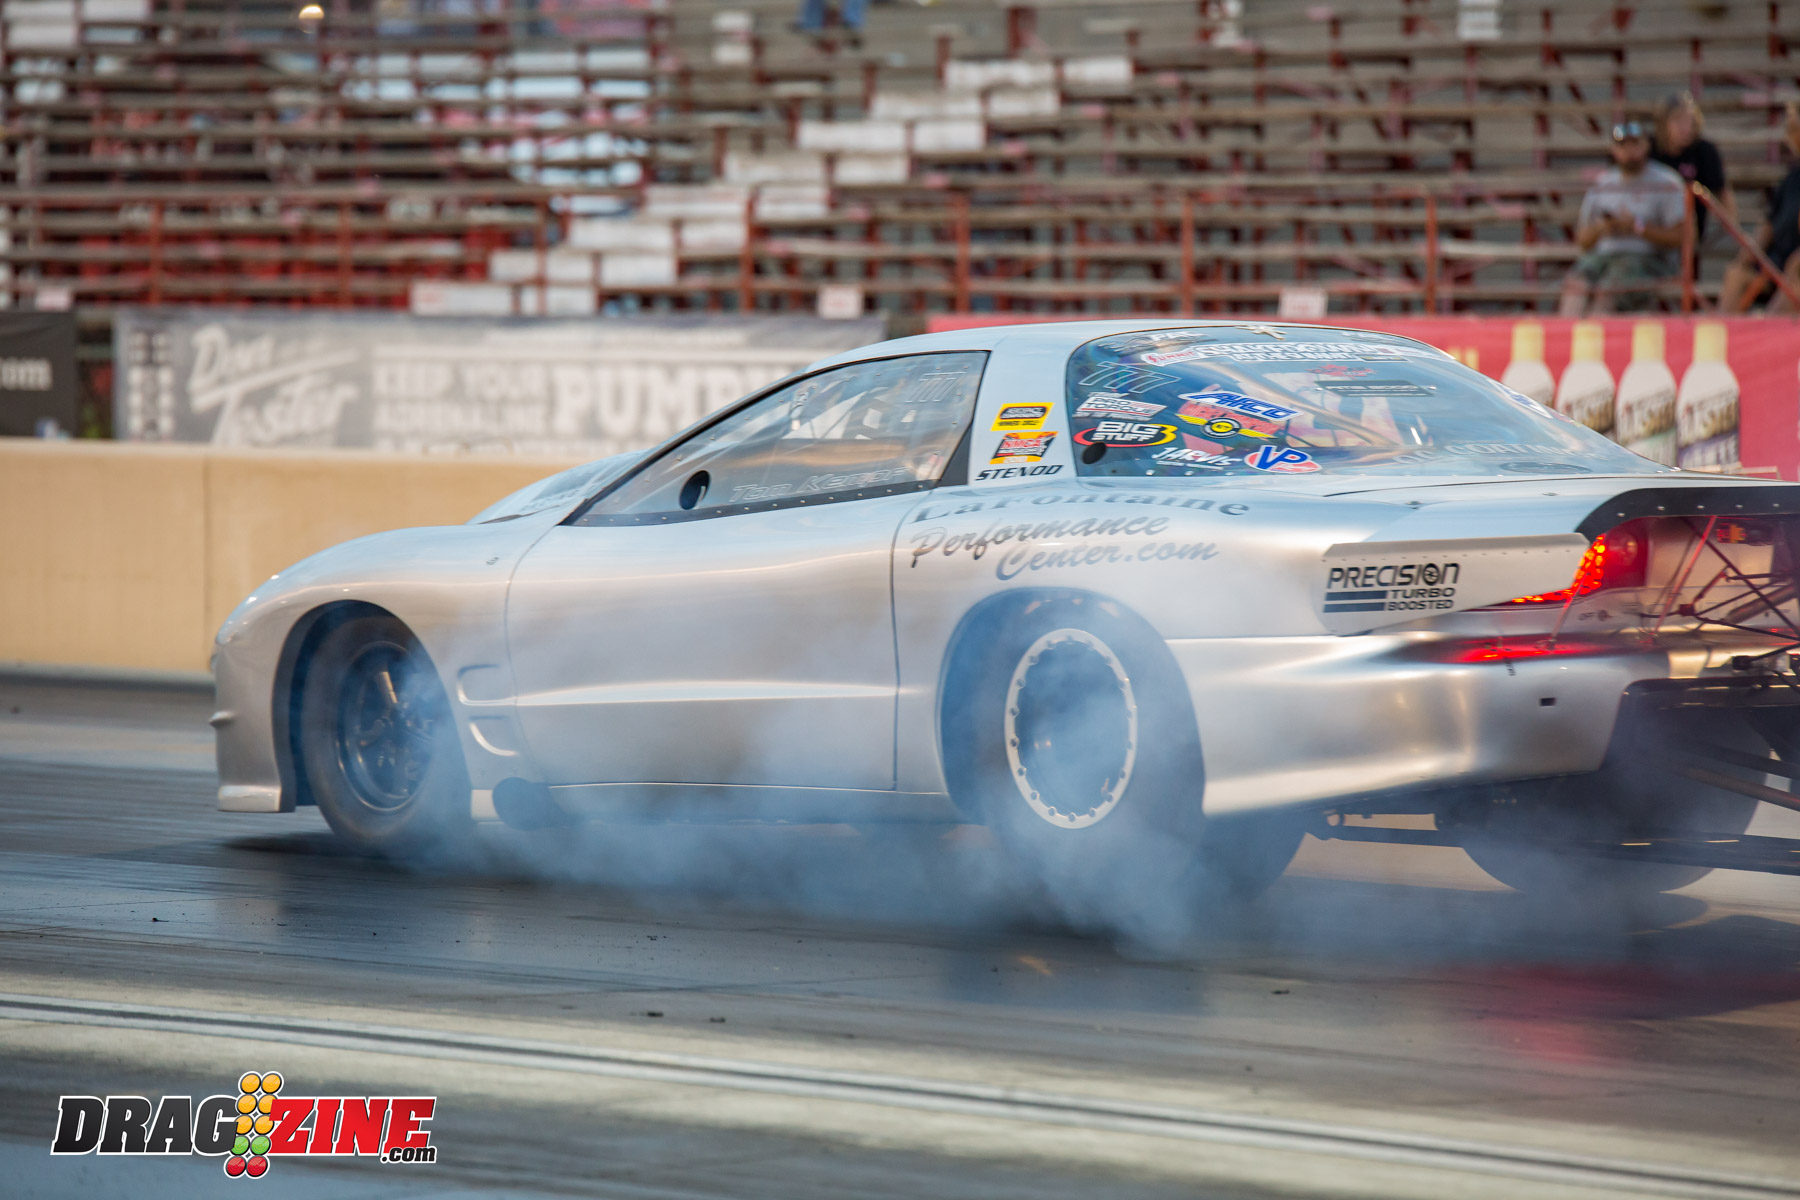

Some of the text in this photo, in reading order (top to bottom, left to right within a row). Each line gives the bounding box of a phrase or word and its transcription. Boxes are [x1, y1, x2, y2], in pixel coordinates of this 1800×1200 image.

[1096, 421, 1162, 434] BIG
[1091, 432, 1156, 442] STUFF
[1151, 447, 1243, 466] JARVIS
[1257, 446, 1309, 470] VP
[975, 464, 1065, 481] STENOD
[910, 515, 1171, 569] Performance
[995, 540, 1221, 582] Center.com
[1327, 562, 1461, 589] PRECISION
[1390, 587, 1456, 599] TURBO
[1387, 600, 1454, 611] BOOSTED
